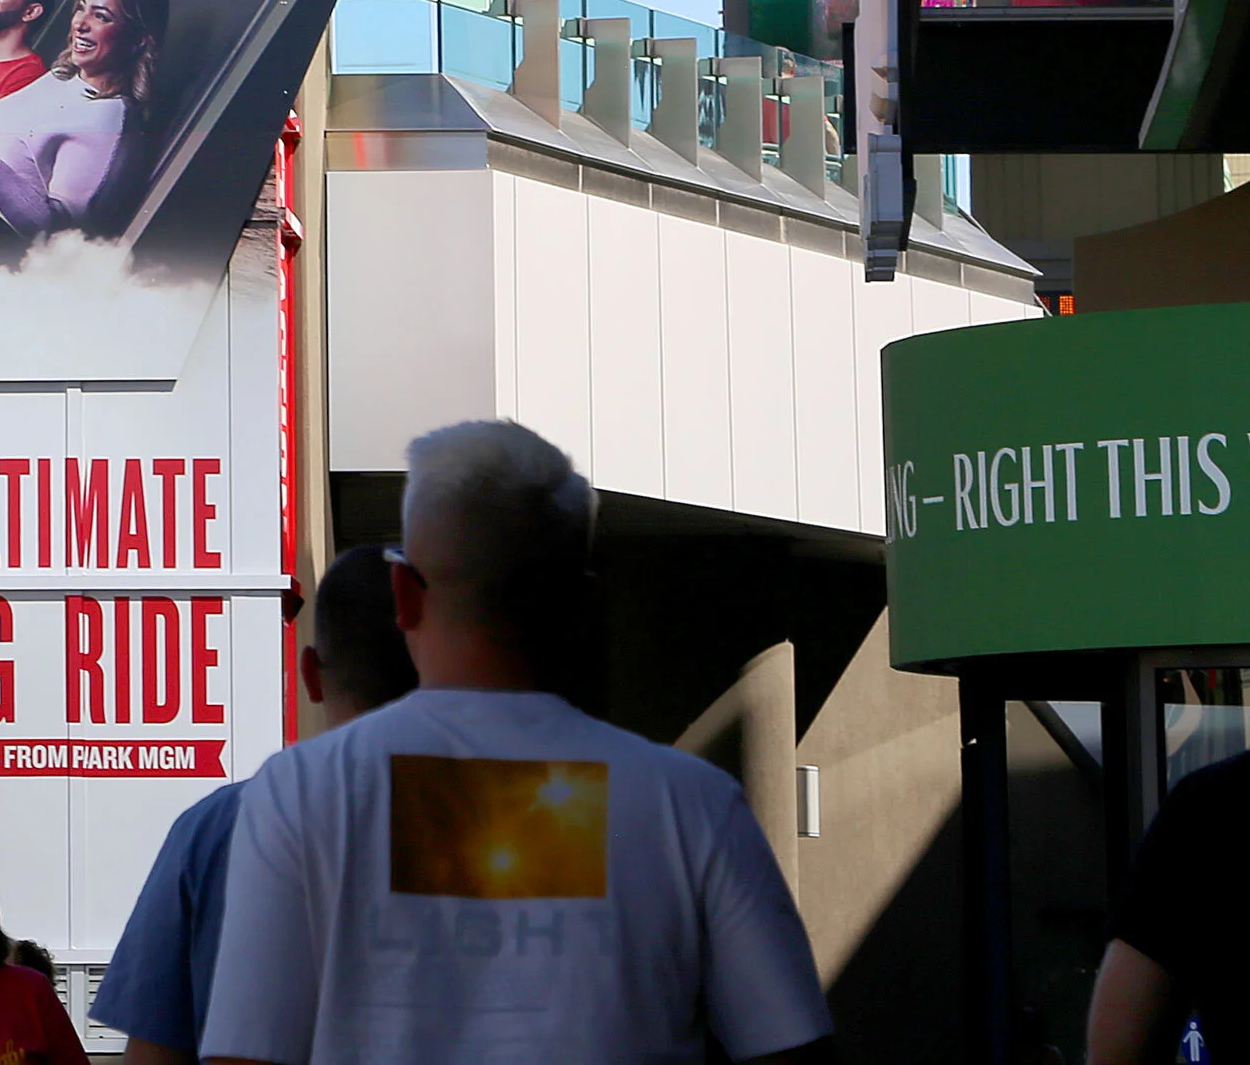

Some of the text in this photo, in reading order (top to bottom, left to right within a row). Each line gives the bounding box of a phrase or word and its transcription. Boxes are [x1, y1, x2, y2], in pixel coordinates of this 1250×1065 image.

[953, 442, 1084, 531] RIGHT
[1097, 432, 1231, 518] THIS
[66, 596, 225, 724] RIDE
[3, 745, 68, 769] FROM
[72, 745, 134, 770] PARK
[138, 745, 196, 770] MGM
